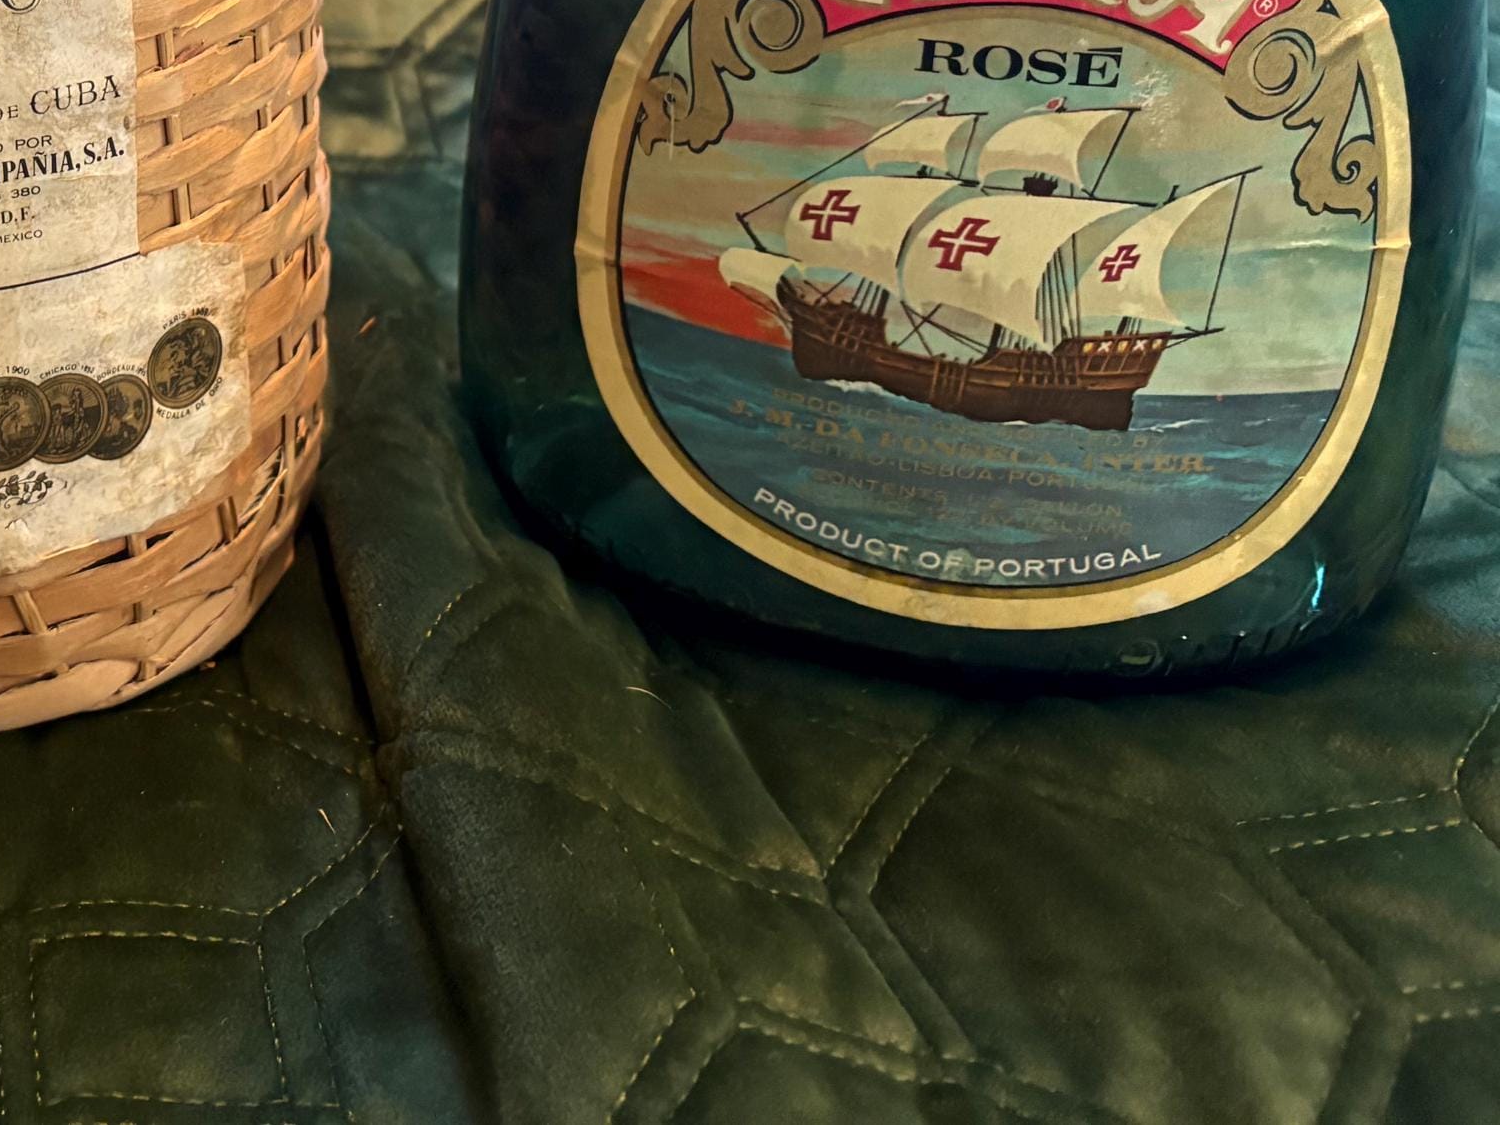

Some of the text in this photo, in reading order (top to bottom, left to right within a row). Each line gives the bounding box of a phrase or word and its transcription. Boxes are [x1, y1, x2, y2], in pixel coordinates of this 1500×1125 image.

[30, 75, 123, 117] CUBA
[15, 134, 53, 151] POR
[83, 136, 126, 166] S.A.
[10, 184, 42, 200] 380
[5, 365, 30, 376] 1900
[40, 363, 77, 380] CHICAGO
[155, 406, 191, 420] MEDALLA
[195, 400, 207, 413] DE
[814, 419, 866, 445] DA
[753, 487, 911, 563] PRODUCT
[919, 551, 965, 574] OF
[974, 544, 1162, 578] PORTUGAL
